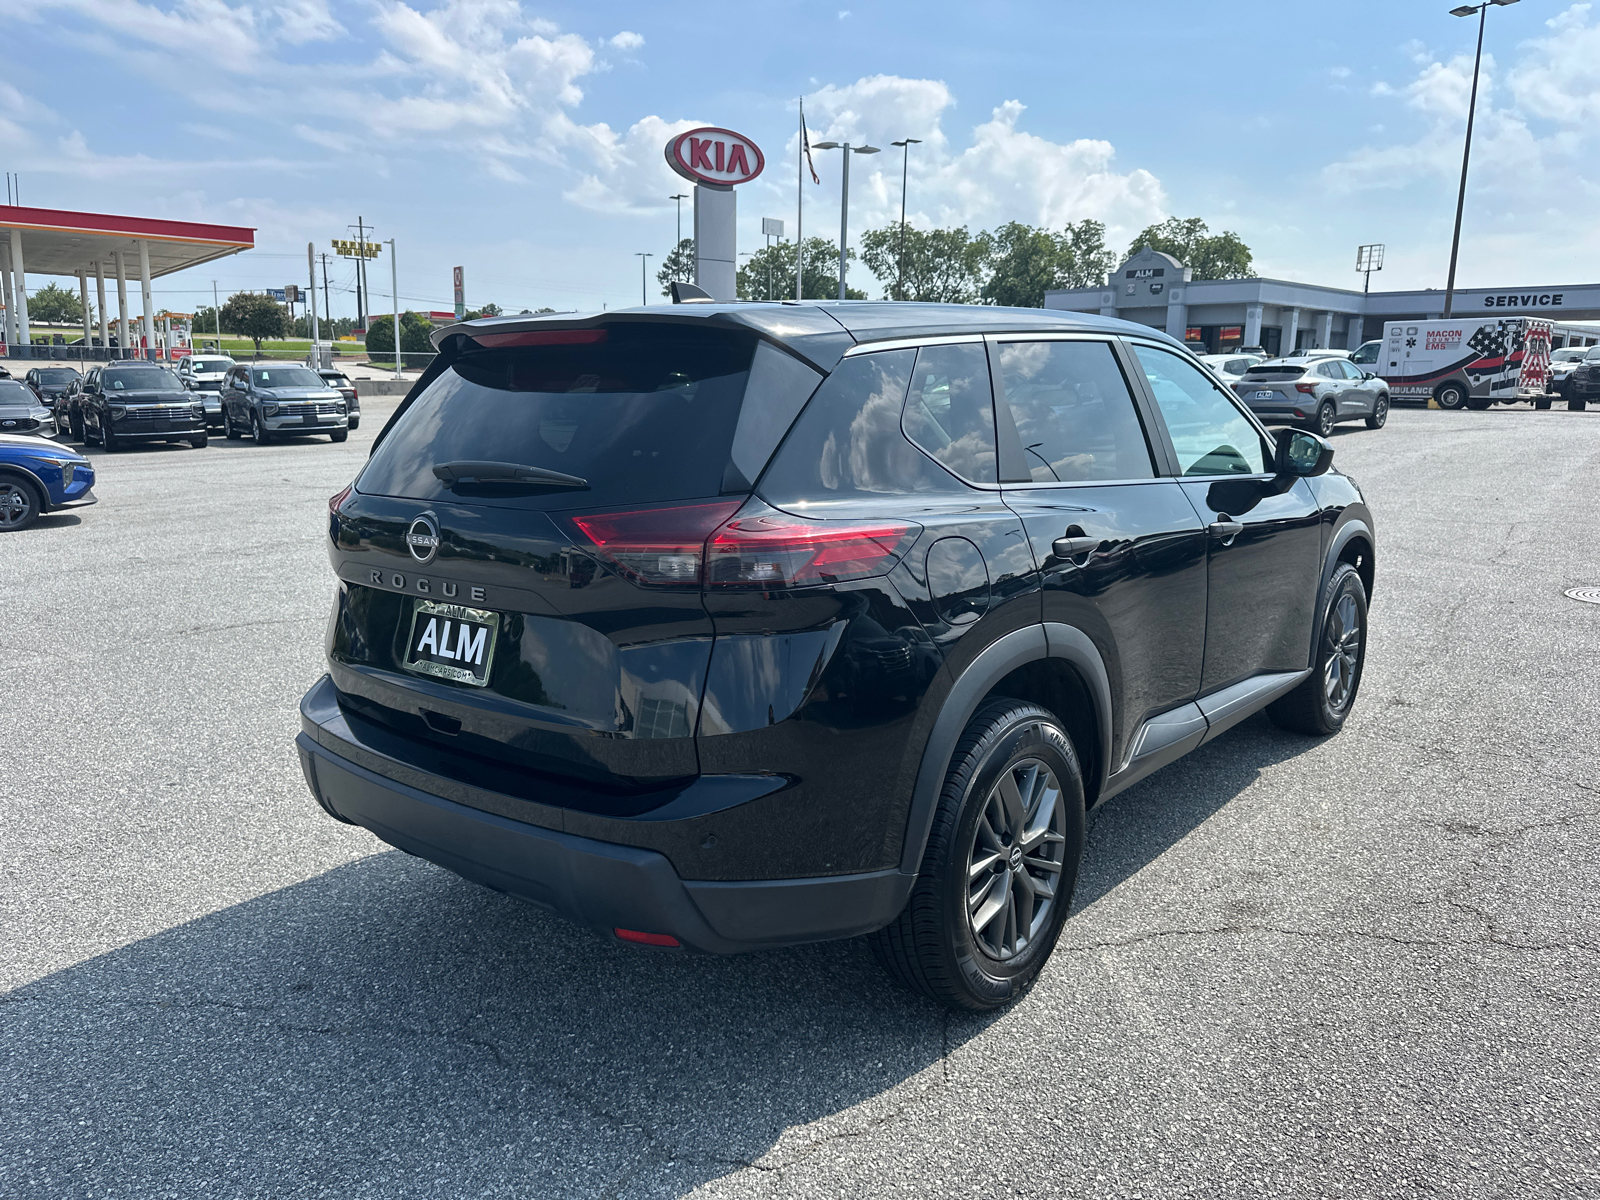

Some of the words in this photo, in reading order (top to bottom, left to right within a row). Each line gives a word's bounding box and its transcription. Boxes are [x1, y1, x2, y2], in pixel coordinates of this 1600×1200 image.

[690, 137, 750, 175] KIA
[338, 249, 377, 257] HOUSE
[1135, 269, 1153, 278] ALM
[1484, 294, 1563, 307] SERVICE
[1426, 330, 1462, 338] MACON
[406, 534, 438, 546] NSSAN
[370, 569, 487, 602] ROGUE
[445, 604, 467, 619] ALM
[417, 617, 488, 666] ALM
